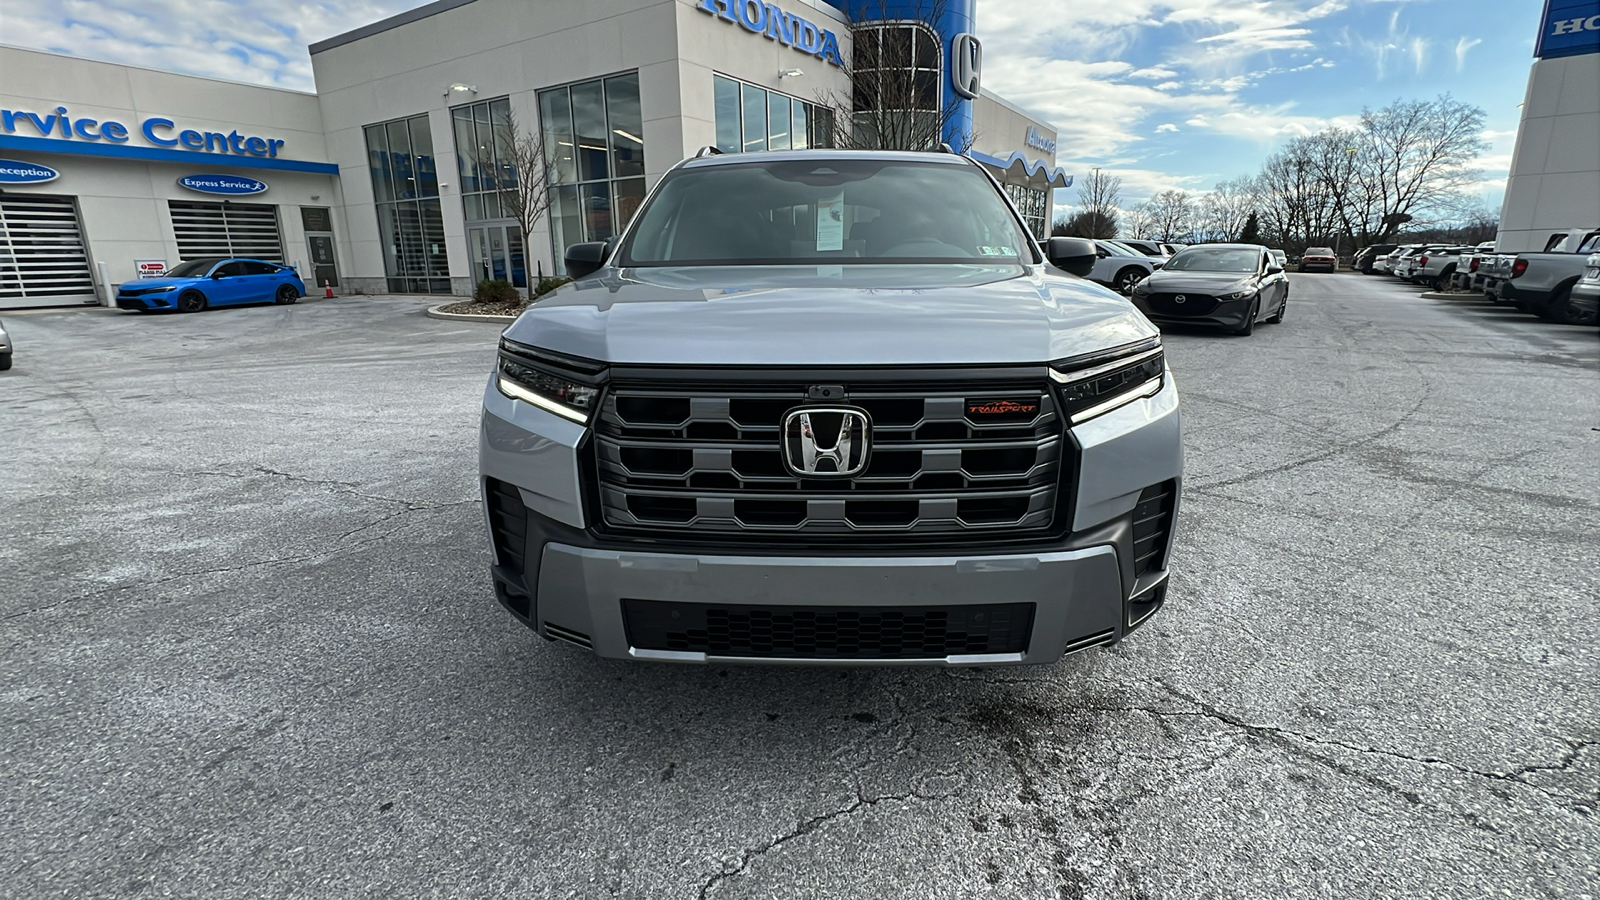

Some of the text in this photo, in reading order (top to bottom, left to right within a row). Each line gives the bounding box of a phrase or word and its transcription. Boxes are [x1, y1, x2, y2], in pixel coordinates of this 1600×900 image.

[698, 0, 845, 66] HONDA
[1, 106, 285, 158] rvice Center
[184, 178, 251, 189] Express Service
[969, 405, 1037, 414] TRAILSPORT
